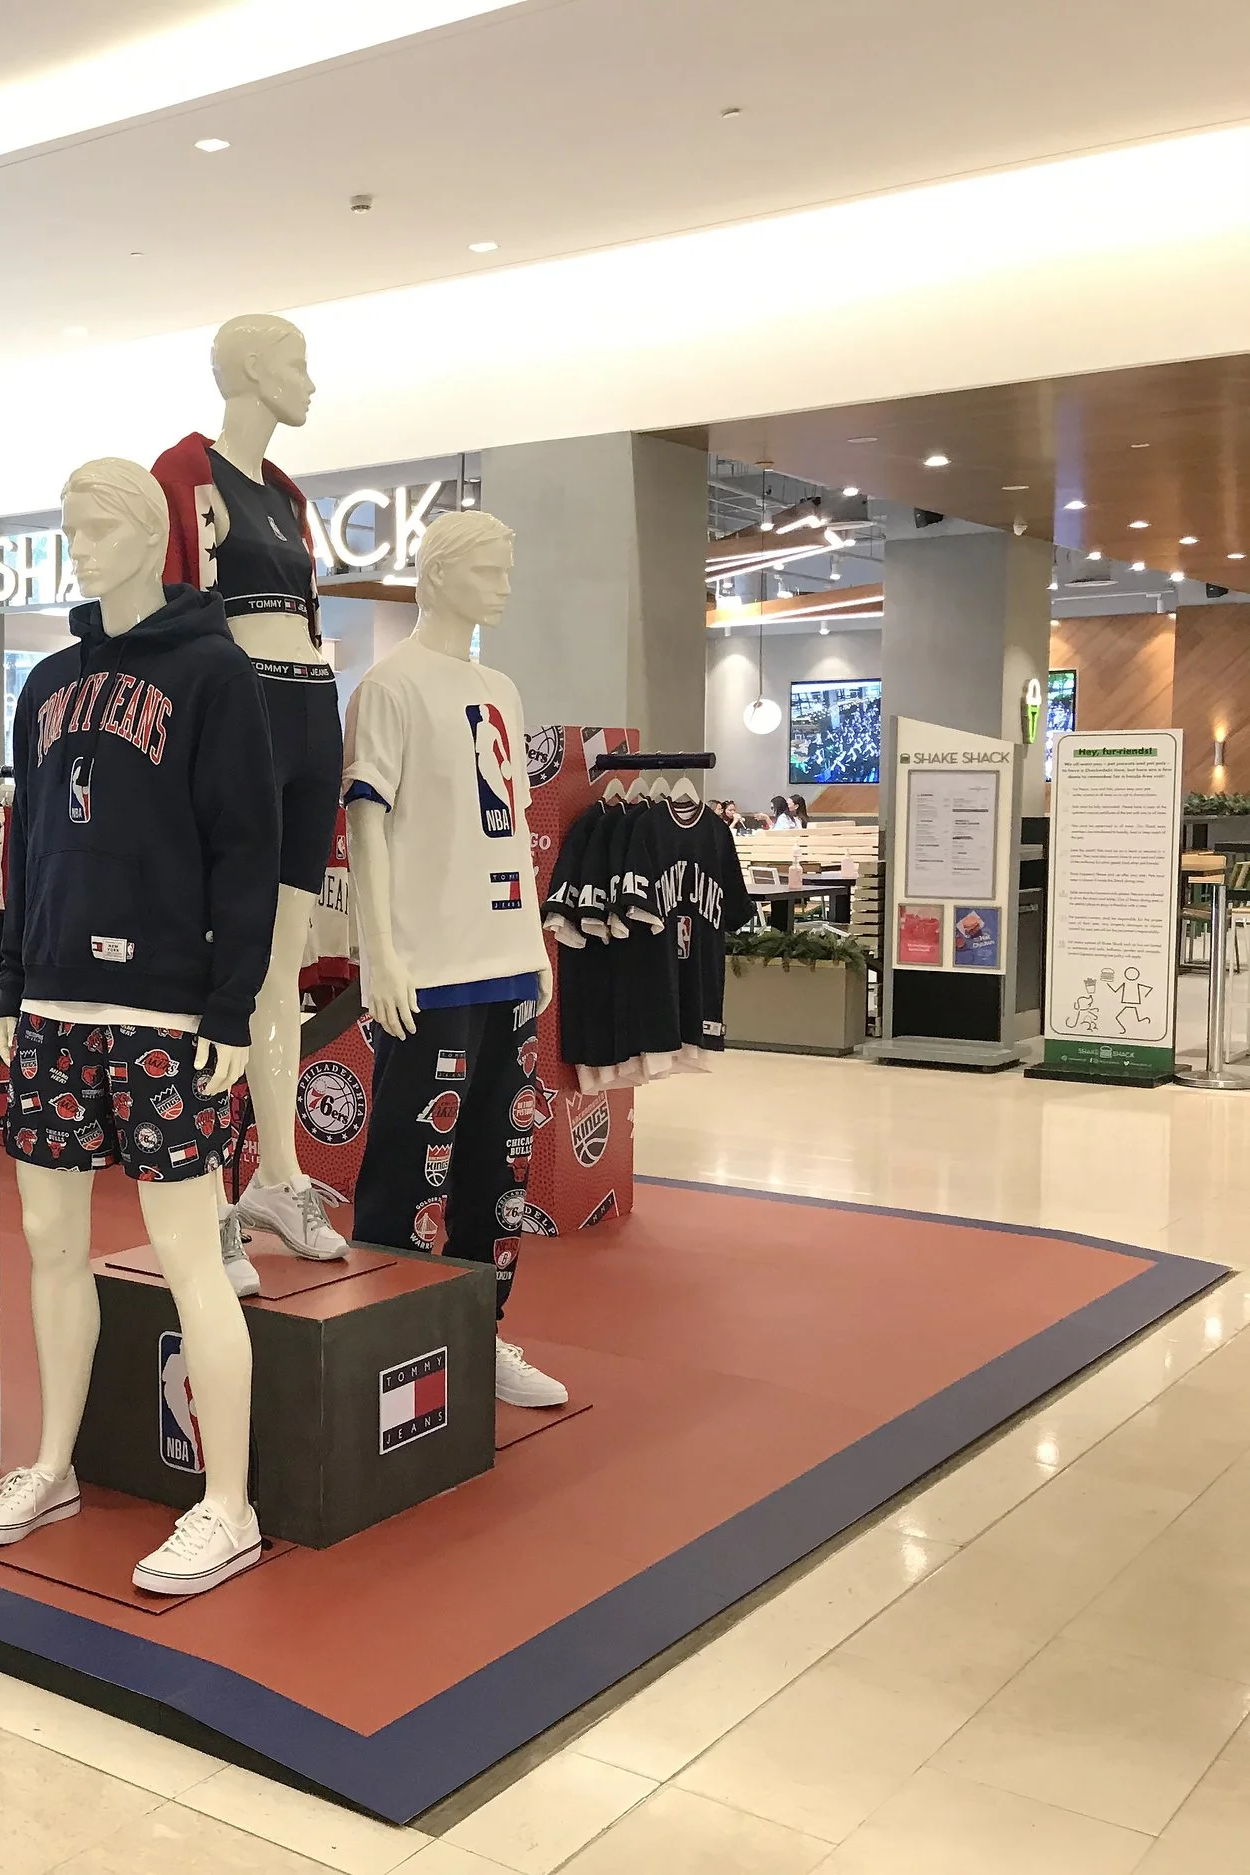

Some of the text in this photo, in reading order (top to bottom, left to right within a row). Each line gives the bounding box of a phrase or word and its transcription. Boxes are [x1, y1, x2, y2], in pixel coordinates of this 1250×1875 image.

[306, 481, 442, 570] ACK
[248, 600, 282, 609] TOMMY
[310, 668, 330, 677] JEANS
[37, 672, 173, 768] TOMMY JEANS
[913, 751, 1011, 764] SHAKE SHACK
[1078, 748, 1100, 757] Hey,
[71, 807, 83, 819] NBA
[485, 808, 510, 832] NBA
[318, 875, 349, 916] JEA
[299, 1063, 364, 1117] PHILADELPHIA
[308, 1087, 350, 1124] 76ers
[573, 1101, 608, 1143] KINGS
[592, 1198, 614, 1223] MMY
[386, 1356, 442, 1387] TOMMY
[386, 1411, 443, 1445] JEANS
[166, 1436, 189, 1462] NBA
